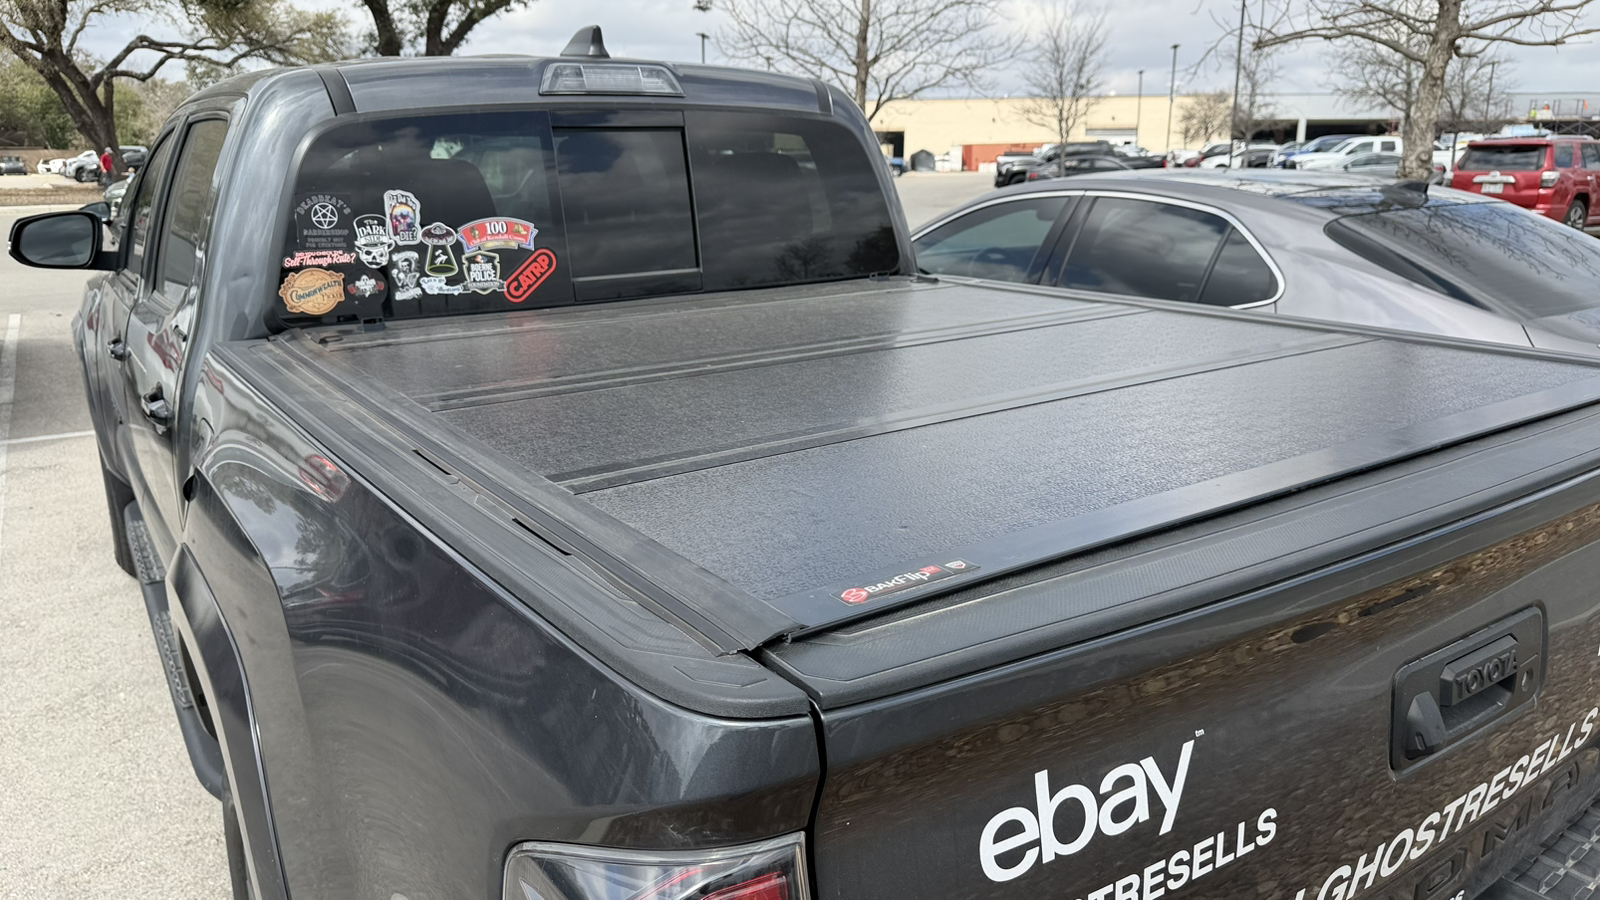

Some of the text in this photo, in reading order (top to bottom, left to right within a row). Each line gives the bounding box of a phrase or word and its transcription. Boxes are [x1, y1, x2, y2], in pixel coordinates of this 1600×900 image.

[358, 225, 386, 237] DARK
[400, 227, 417, 241] DIE?
[485, 221, 508, 235] 100
[470, 262, 493, 271] BOERNE
[470, 270, 497, 281] POLICE
[509, 254, 551, 297] CATRP
[1455, 649, 1518, 700] TOYOTA
[979, 739, 1195, 883] ebay
[1077, 807, 1278, 900] TRESELLS
